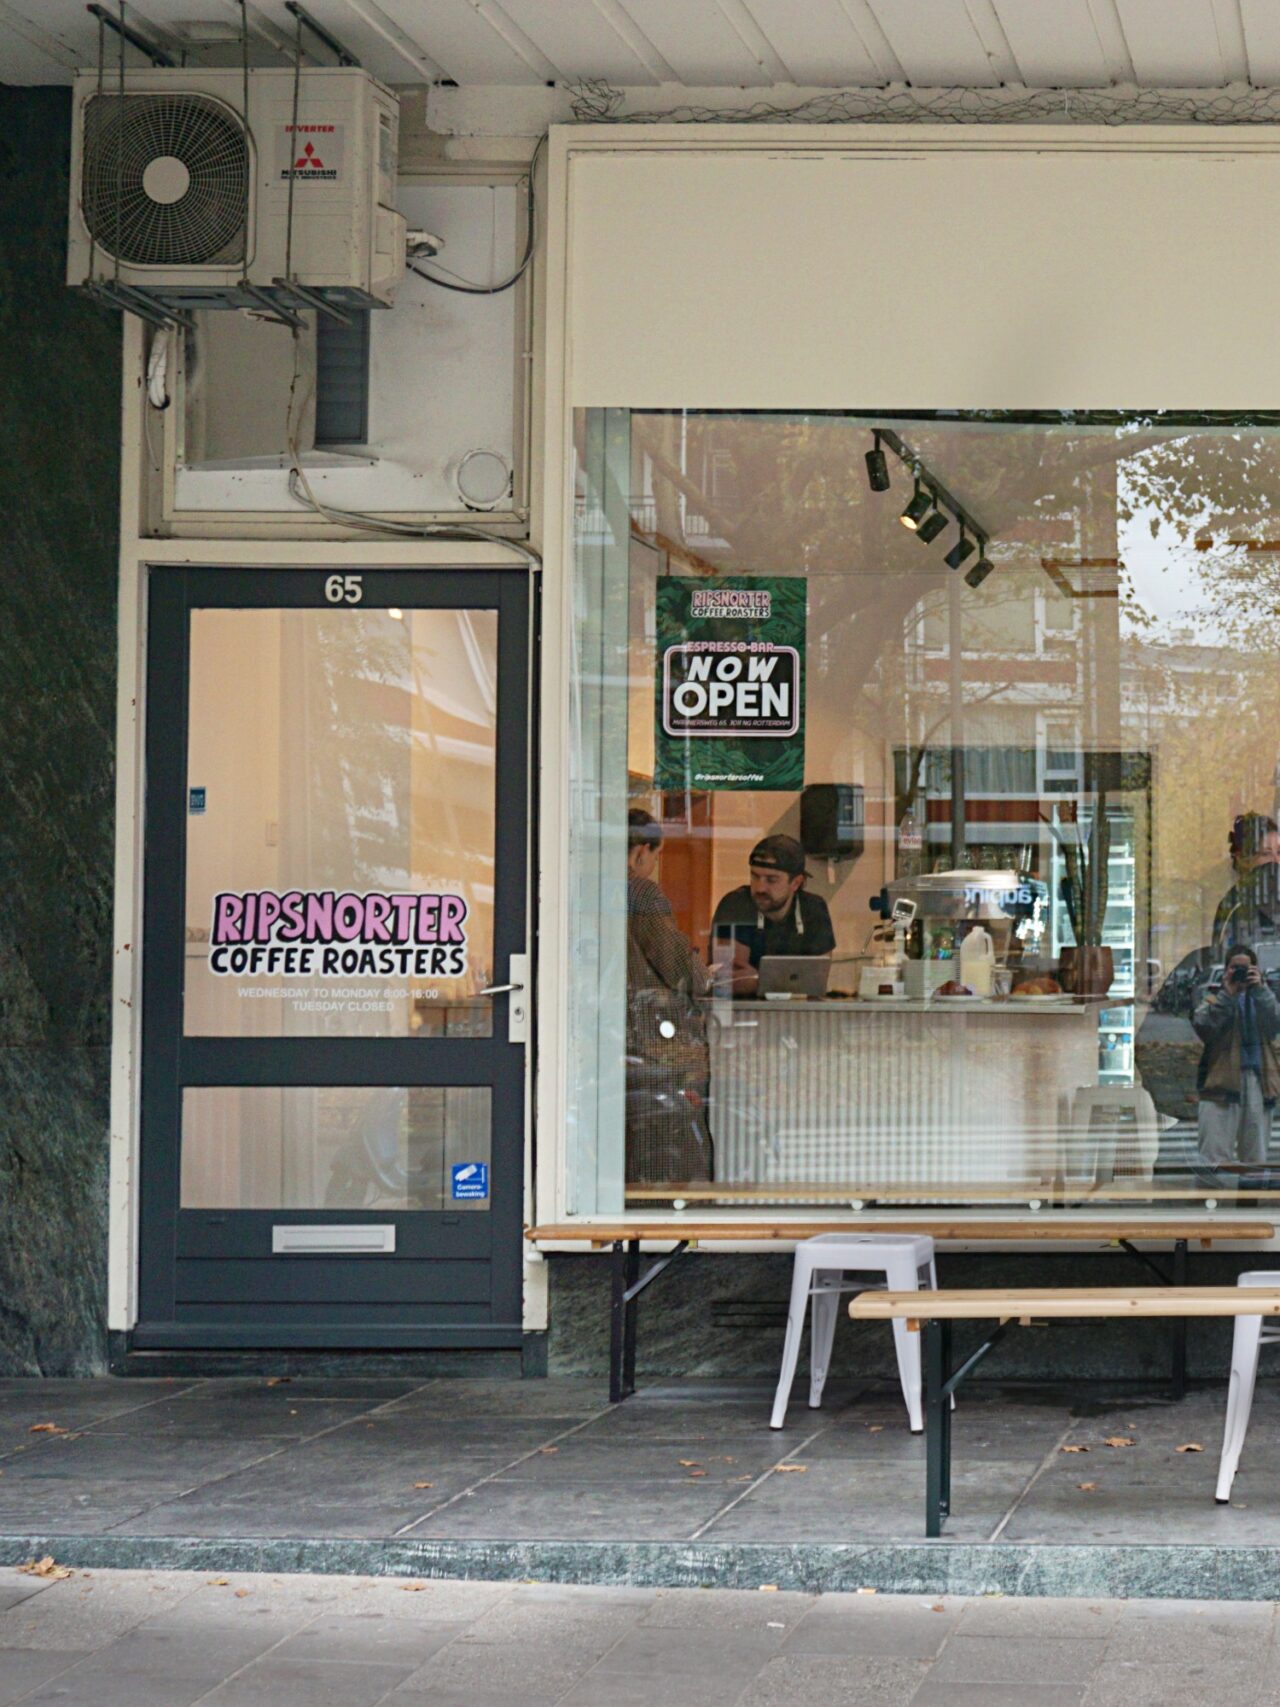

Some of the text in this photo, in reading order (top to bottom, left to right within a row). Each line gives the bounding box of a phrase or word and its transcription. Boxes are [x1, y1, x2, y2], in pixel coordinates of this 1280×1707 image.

[325, 575, 362, 604] 65
[692, 591, 770, 608] RIPSNORTER
[692, 607, 770, 617] COFFEE ROASTERS
[687, 642, 774, 653] ESPRESSO BAR
[687, 656, 779, 682] NOW
[673, 681, 789, 717] OPEN
[212, 891, 467, 946] RIPSNORTER
[211, 947, 465, 974] COFFEE ROASTERS
[238, 988, 310, 998] WEDNESDAY
[312, 988, 329, 998] TO
[331, 988, 379, 998] MONDAY
[292, 1002, 394, 1012] TUESDAY CLOSED
